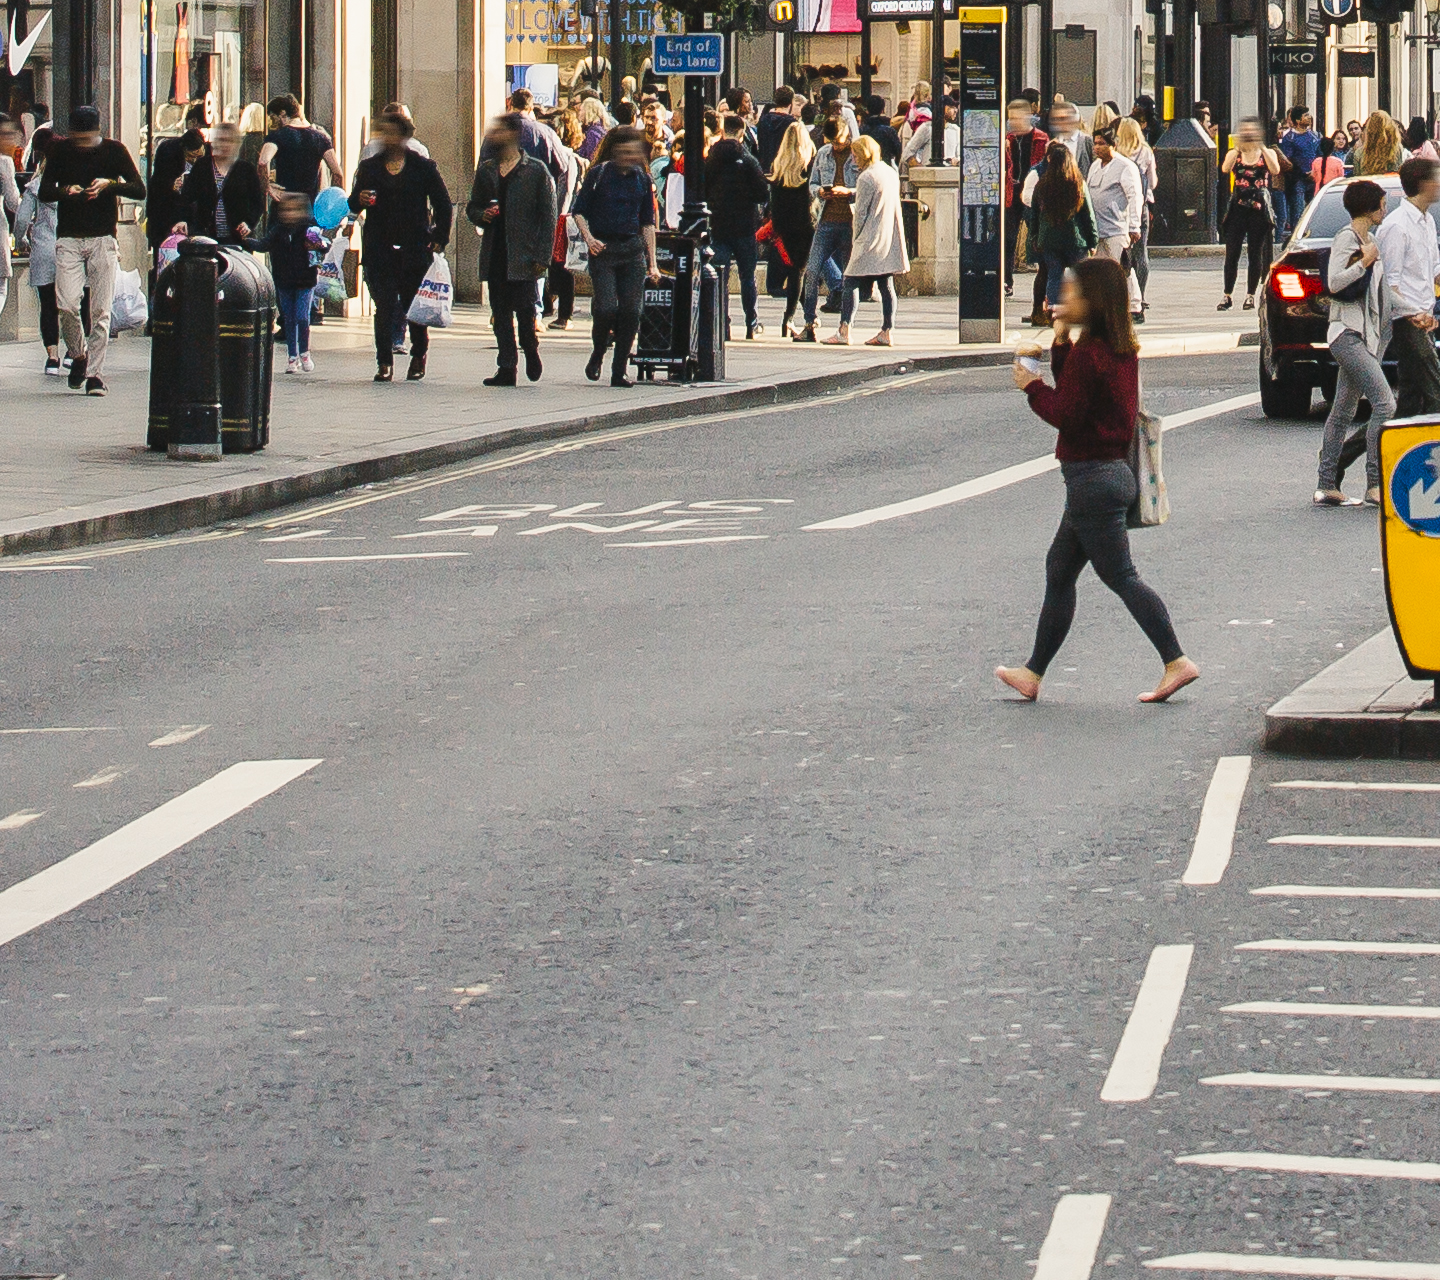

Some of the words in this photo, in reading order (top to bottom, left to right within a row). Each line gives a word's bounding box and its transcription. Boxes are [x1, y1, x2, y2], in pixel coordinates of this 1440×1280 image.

[666, 39, 692, 53] End
[697, 39, 712, 52] of
[659, 54, 683, 68] bus
[687, 54, 717, 68] lane
[1272, 52, 1315, 64] KIKO
[644, 289, 672, 302] FREE
[418, 497, 796, 522] BUS
